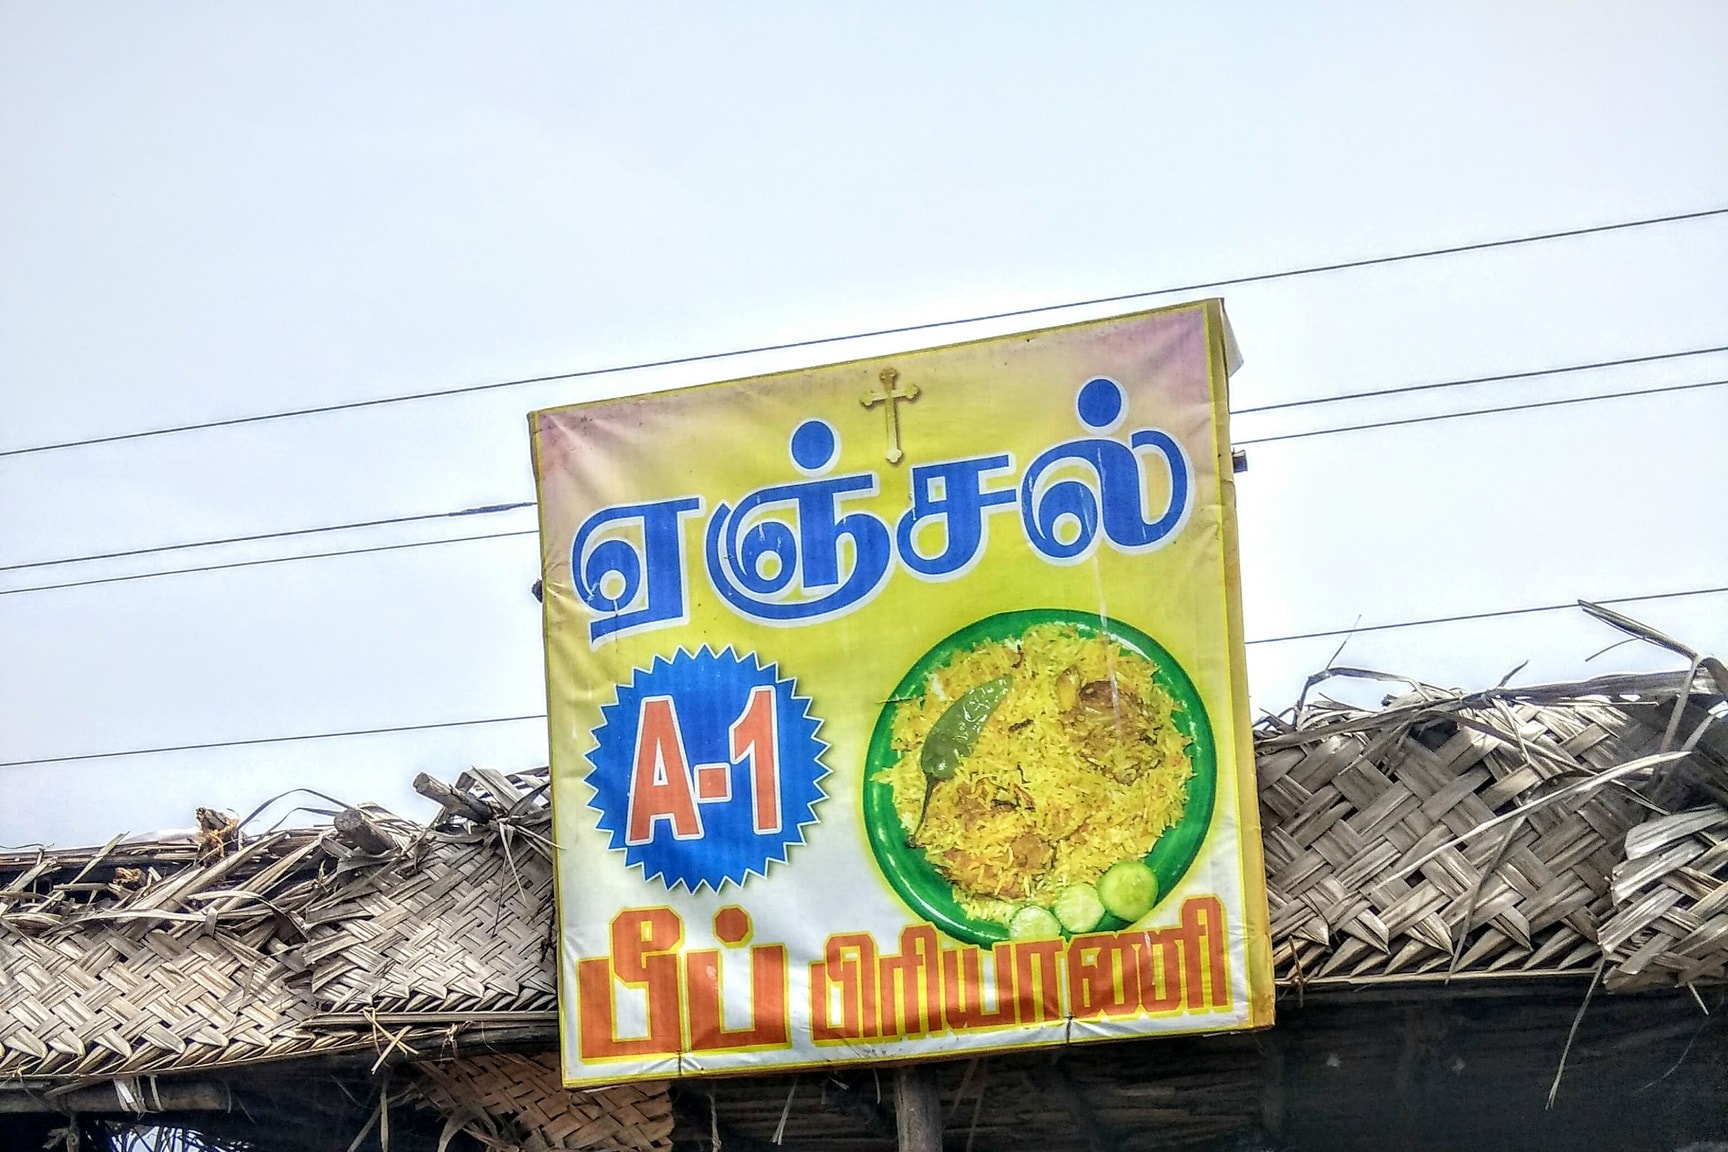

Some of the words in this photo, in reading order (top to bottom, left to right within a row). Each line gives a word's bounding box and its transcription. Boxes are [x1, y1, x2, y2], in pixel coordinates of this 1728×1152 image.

[572, 377, 1190, 645] ஏஞ்சல்
[627, 686, 783, 845] A-1
[577, 905, 793, 1061] பீப்
[809, 895, 1233, 1046] பிரியாணி
